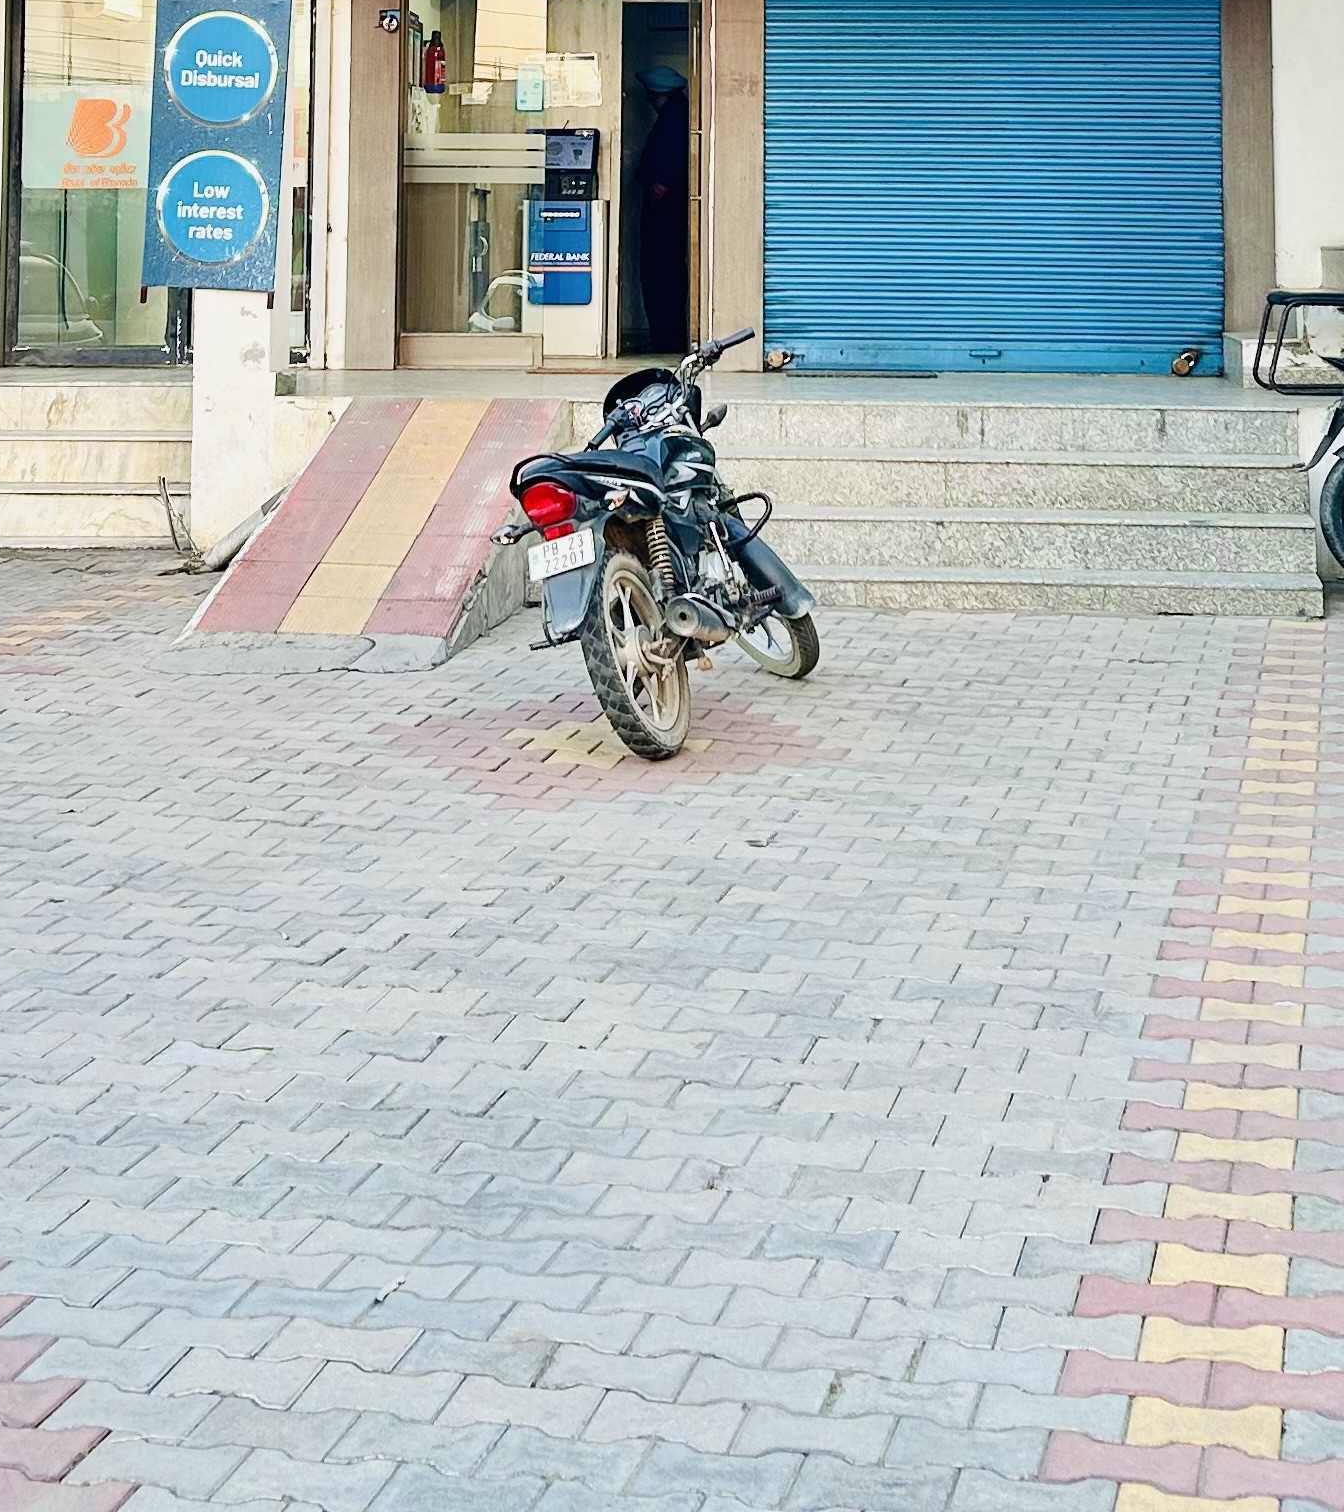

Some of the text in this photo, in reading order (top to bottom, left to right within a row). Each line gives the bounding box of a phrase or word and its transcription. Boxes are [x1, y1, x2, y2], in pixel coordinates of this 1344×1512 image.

[195, 49, 243, 67] Quick
[181, 70, 260, 89] Disbursal
[193, 181, 230, 199] Low
[177, 200, 244, 220] interest
[188, 224, 233, 240] rates
[531, 253, 590, 261] FEDERAL BANK
[569, 534, 584, 550] 23
